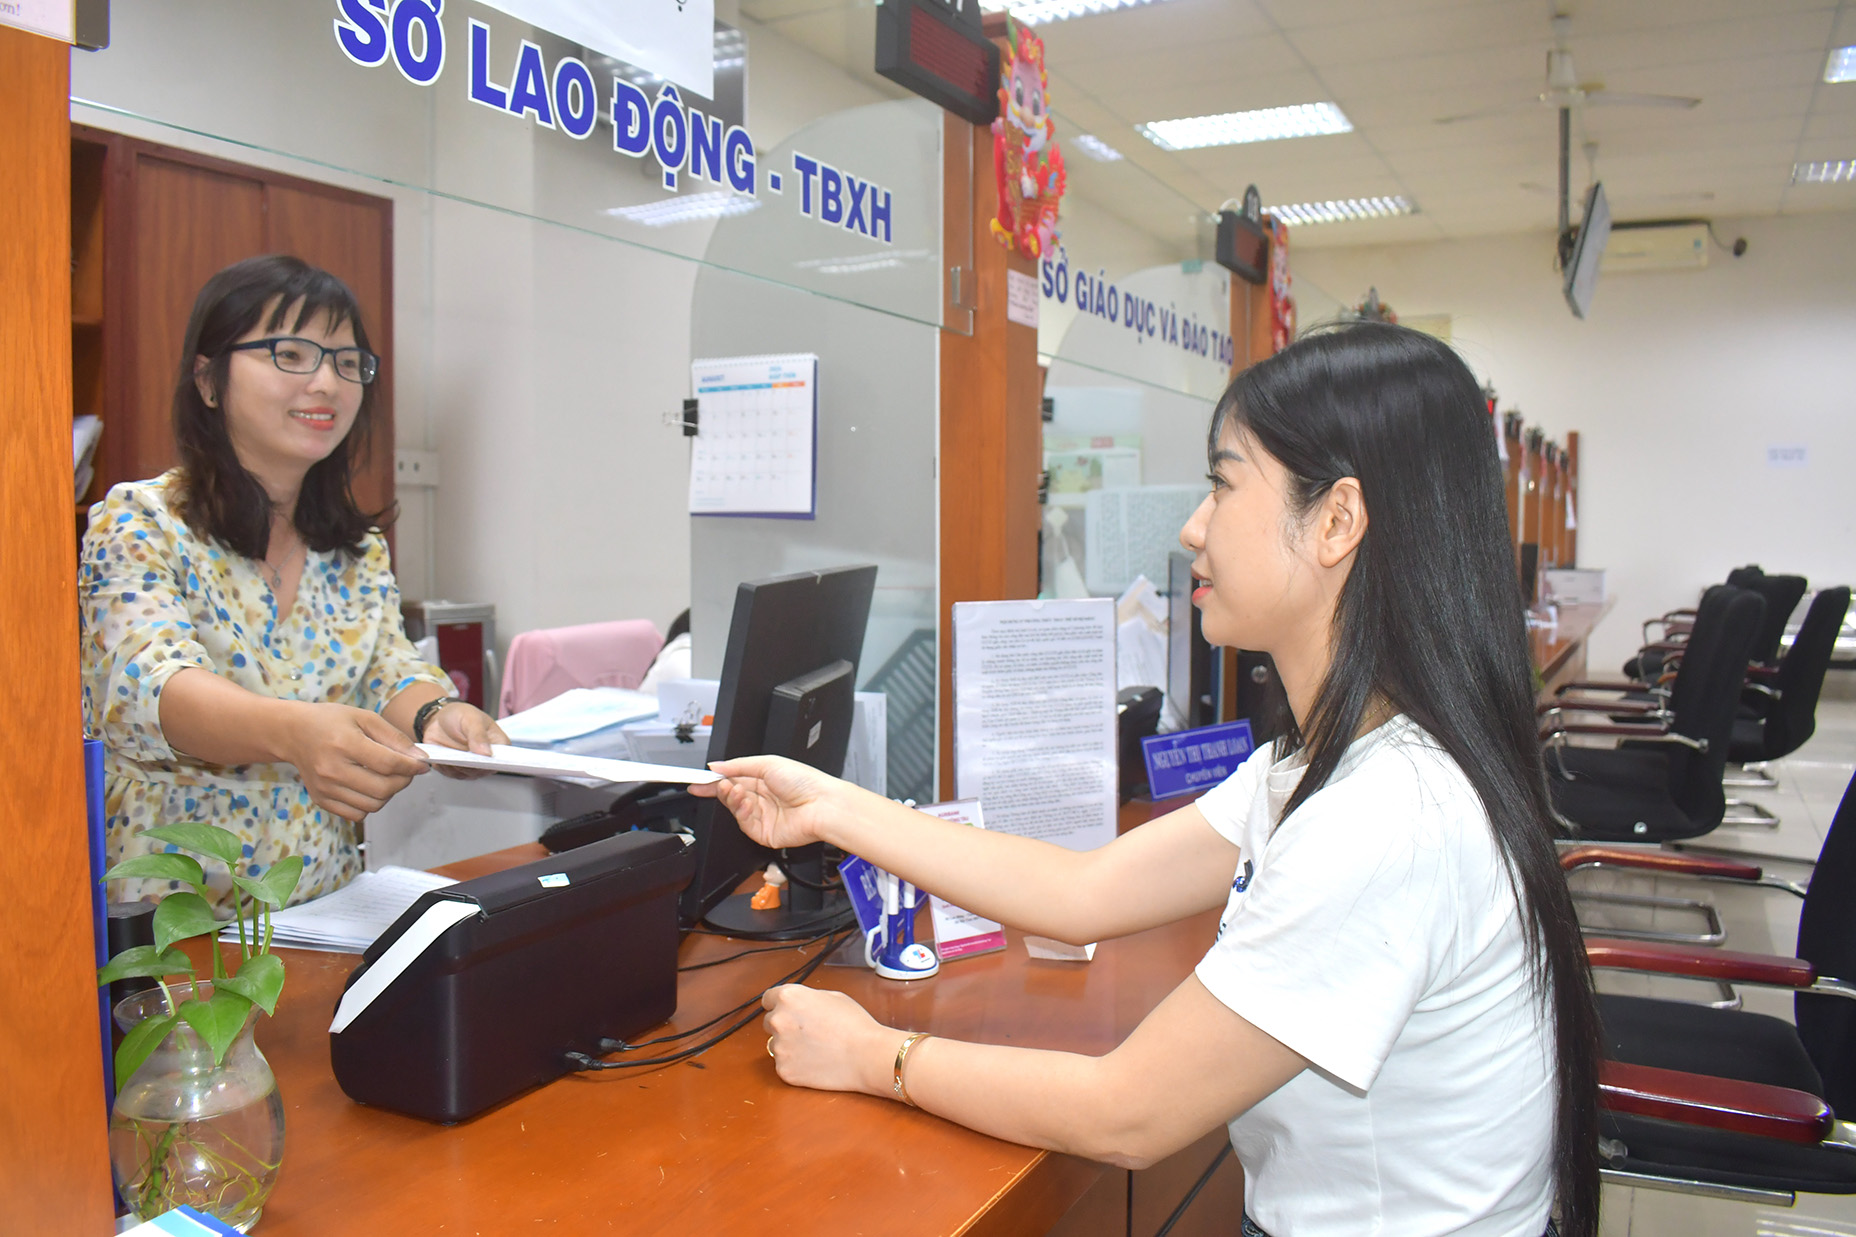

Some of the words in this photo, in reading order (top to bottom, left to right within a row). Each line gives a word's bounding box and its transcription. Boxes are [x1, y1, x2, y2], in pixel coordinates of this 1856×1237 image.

[468, 17, 598, 140] LAO
[610, 76, 757, 199] ĐỘNG
[792, 150, 892, 246] TBXH
[1042, 247, 1069, 303] SỞ
[1075, 269, 1120, 323] GIÁO
[1124, 291, 1155, 345] DỤC
[1159, 302, 1178, 346] VÀ
[1182, 313, 1208, 358] ĐÀO
[1211, 329, 1235, 375] TẠO
